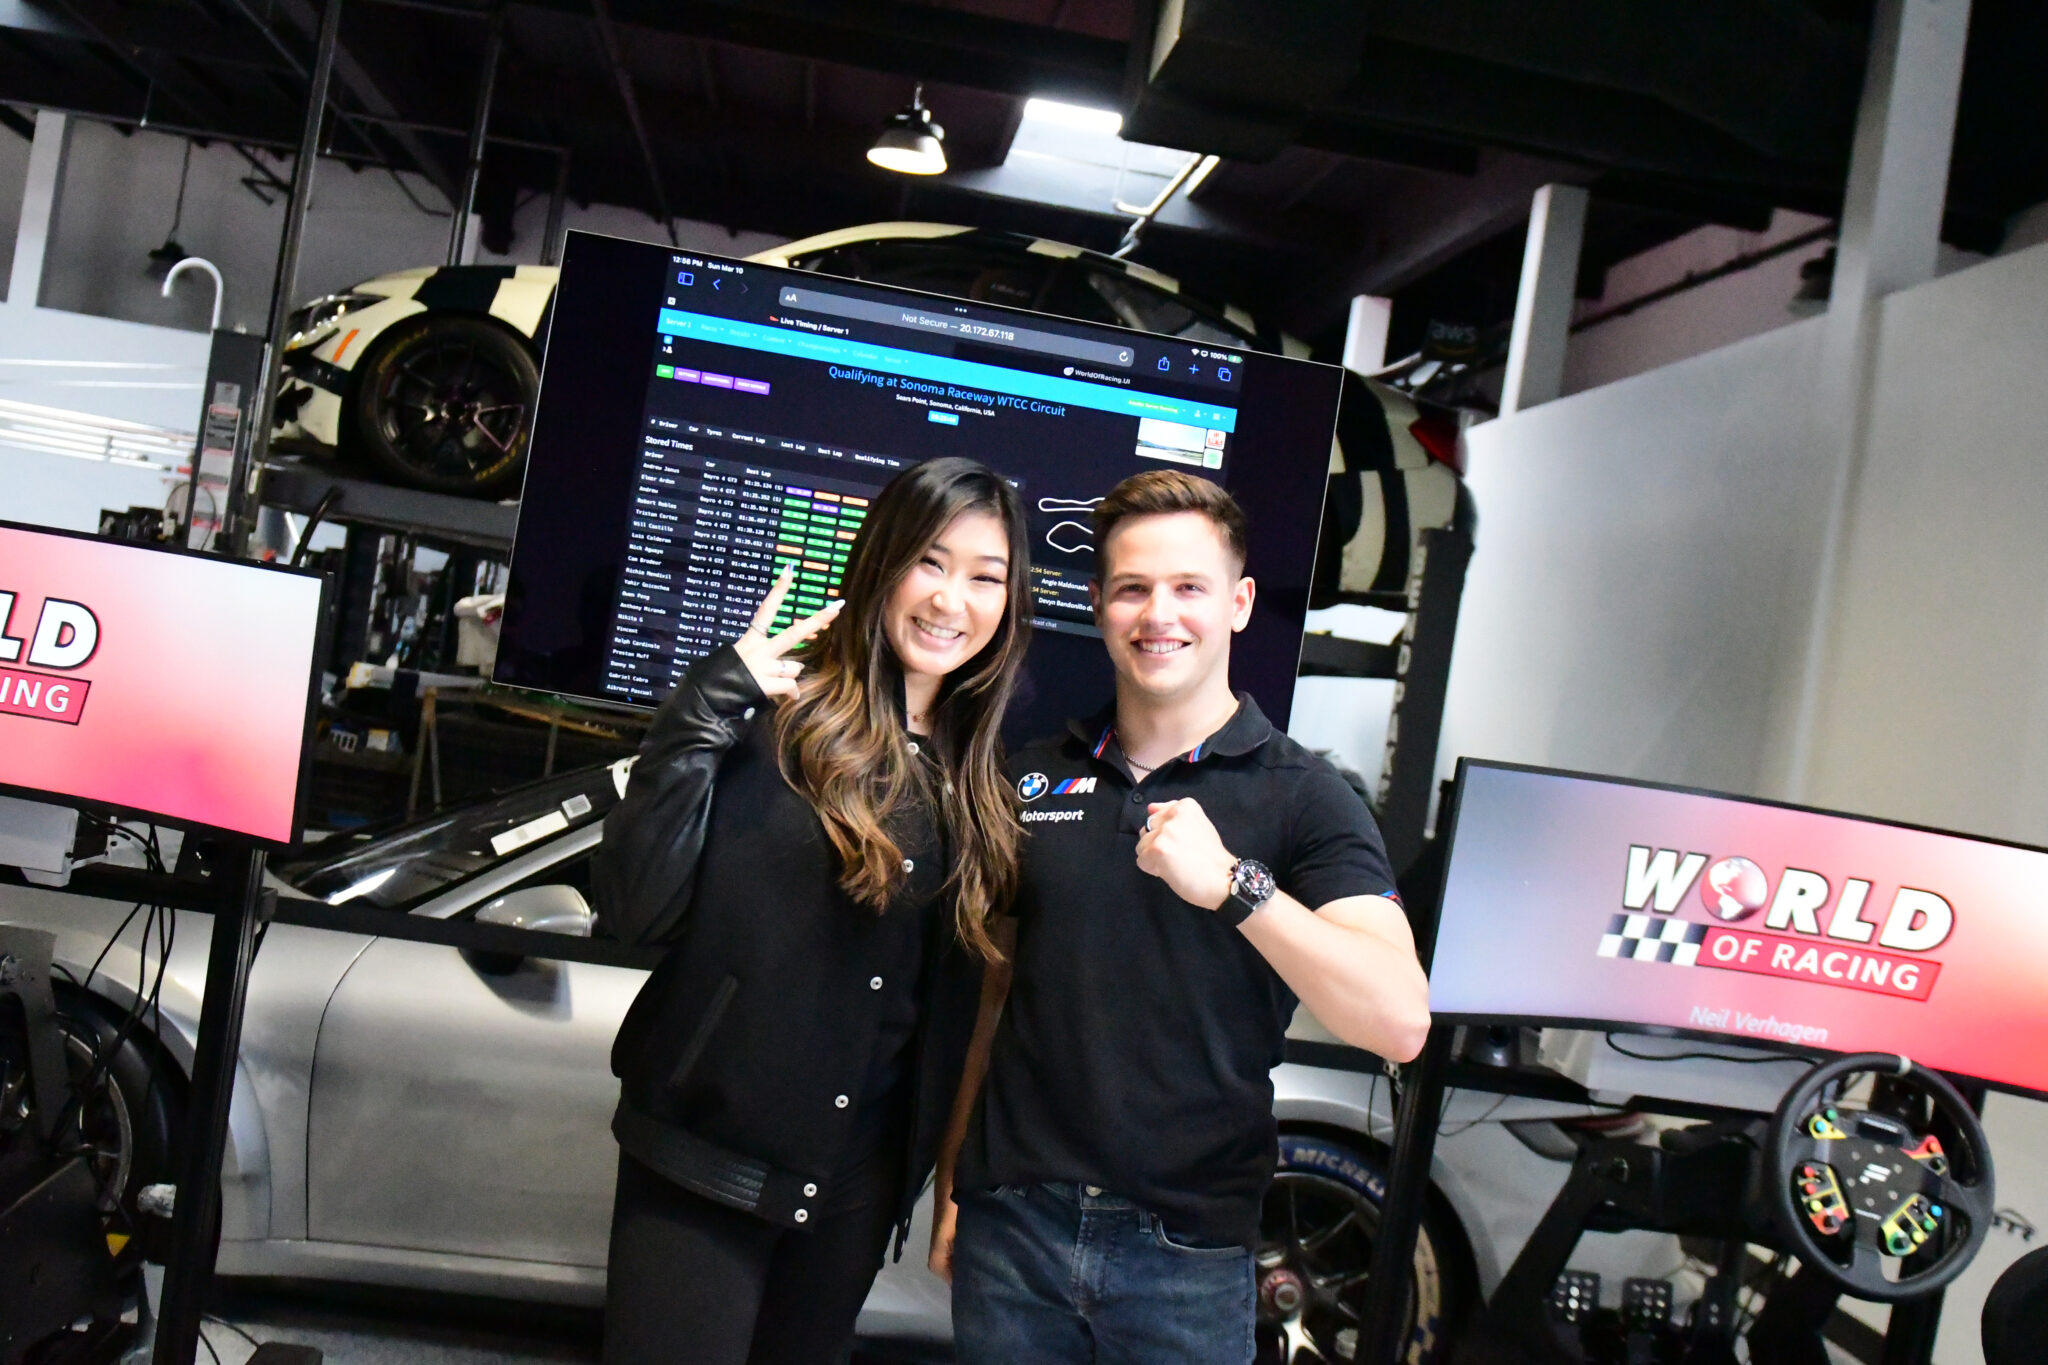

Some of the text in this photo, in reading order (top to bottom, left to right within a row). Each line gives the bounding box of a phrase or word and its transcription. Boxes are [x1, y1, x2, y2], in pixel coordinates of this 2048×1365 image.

[691, 259, 703, 267] PM
[707, 262, 722, 270] Sun
[720, 264, 735, 272] Mar
[780, 317, 795, 326] Live
[795, 319, 819, 331] Timing
[821, 324, 844, 334] Server
[901, 313, 918, 323] Not
[918, 316, 948, 329] Secure
[959, 323, 1014, 341] 20.172.67.118
[1210, 352, 1228, 361] 100%
[828, 365, 1066, 417] Qualifying at Sonoma Raceway WTCC Circuit
[645, 435, 693, 451] Stored Times
[1057, 580, 1089, 592] Maldonado
[1712, 934, 1920, 991] OF RACING
[1689, 1006, 1829, 1044] Neil Verhagen
[1293, 1148, 1385, 1197] MICHEL
